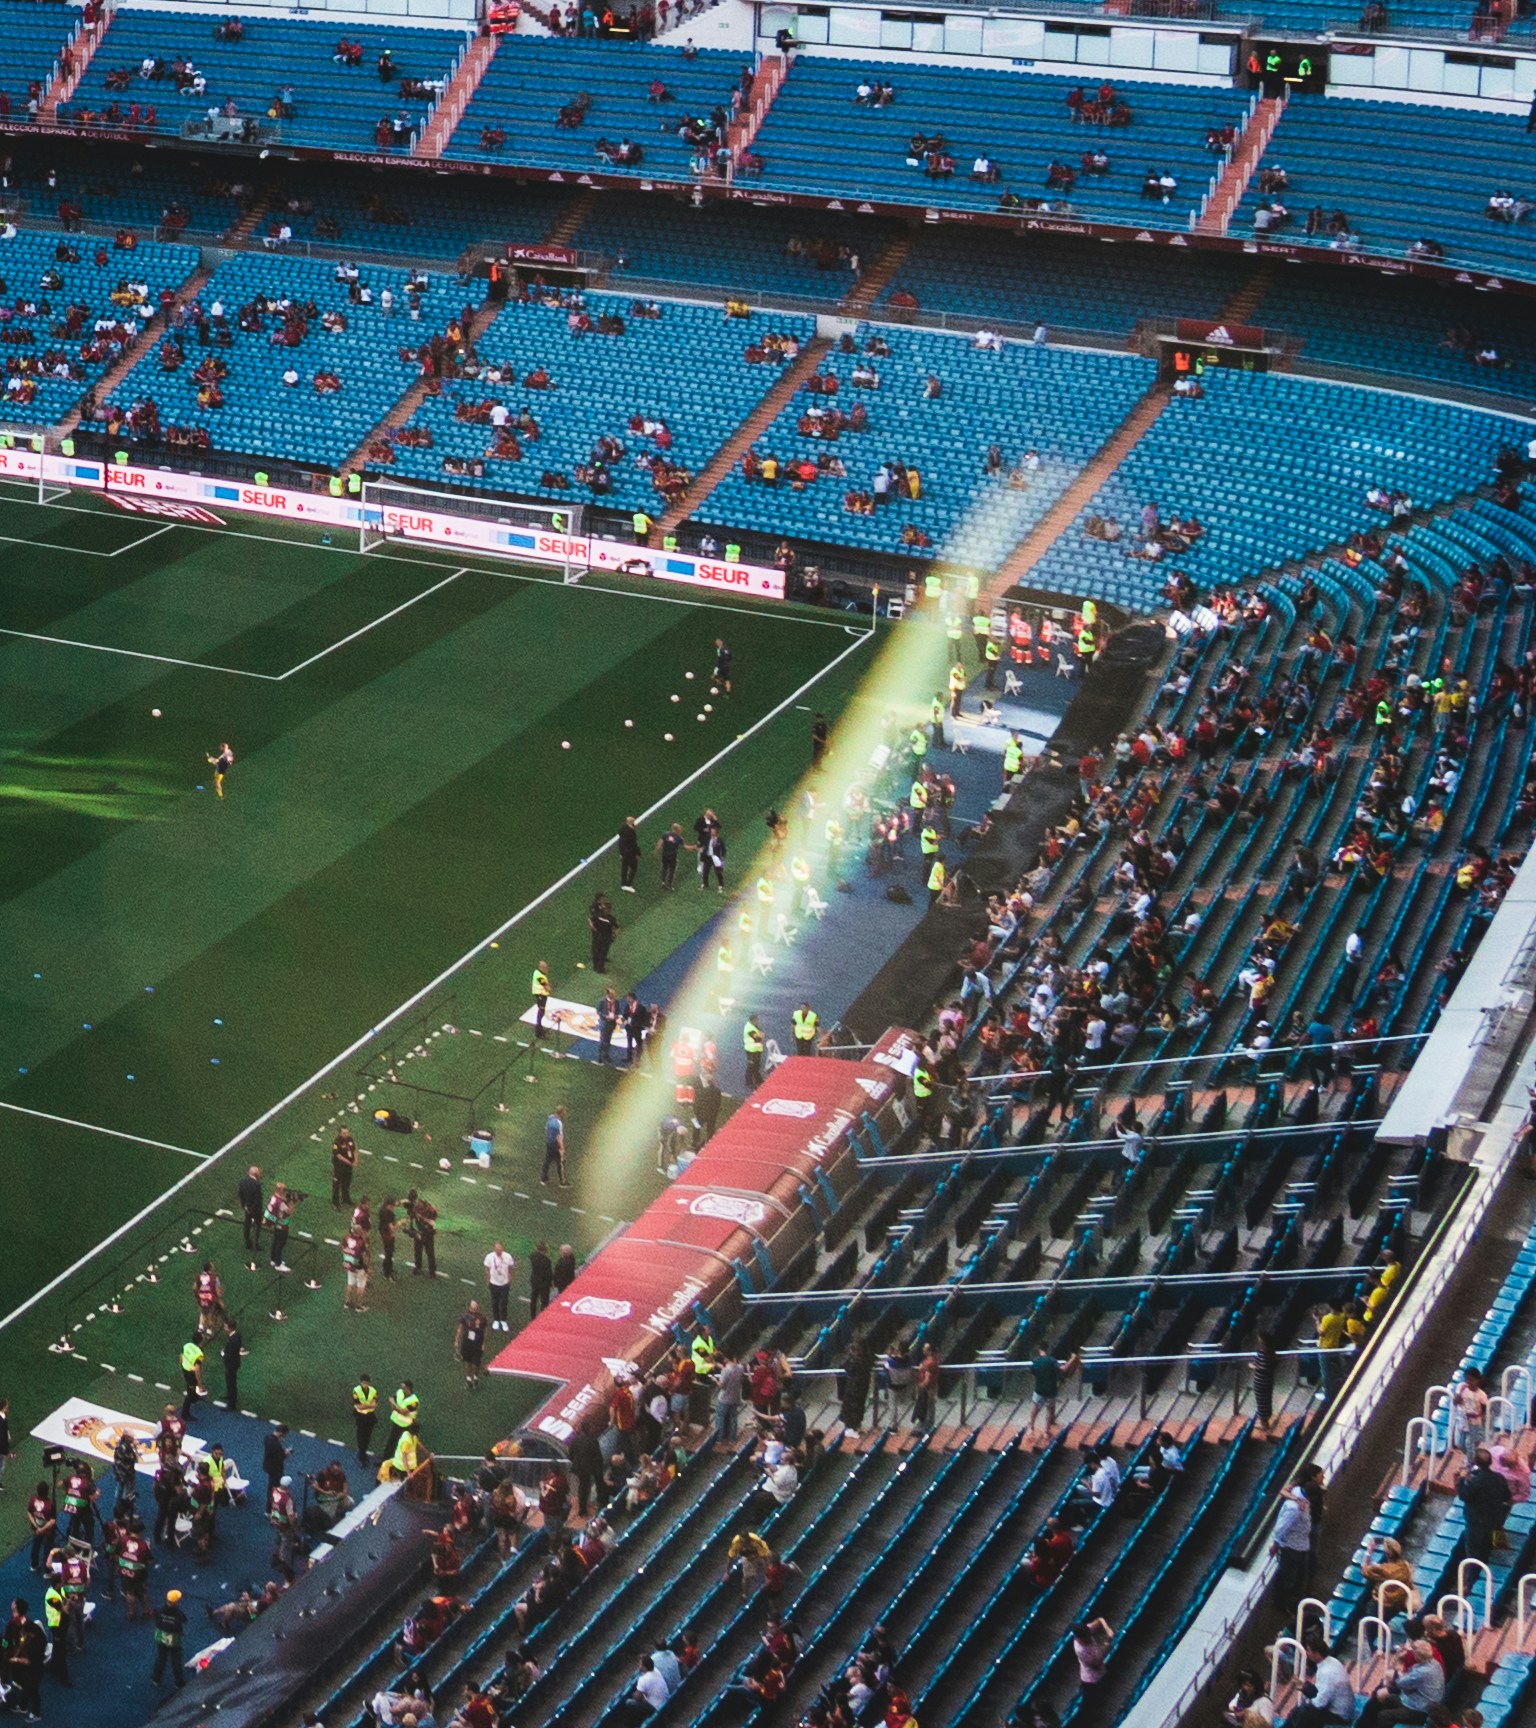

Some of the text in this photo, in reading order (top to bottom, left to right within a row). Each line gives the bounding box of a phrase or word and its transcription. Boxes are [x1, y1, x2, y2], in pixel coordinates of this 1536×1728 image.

[526, 250, 568, 263] CaixaBank
[104, 469, 145, 488] SEUR
[242, 490, 286, 509] SEUR
[388, 513, 433, 532] SEUR
[539, 537, 587, 558] SEUR
[699, 564, 749, 586] SEUR
[560, 1383, 597, 1421] SEAT
